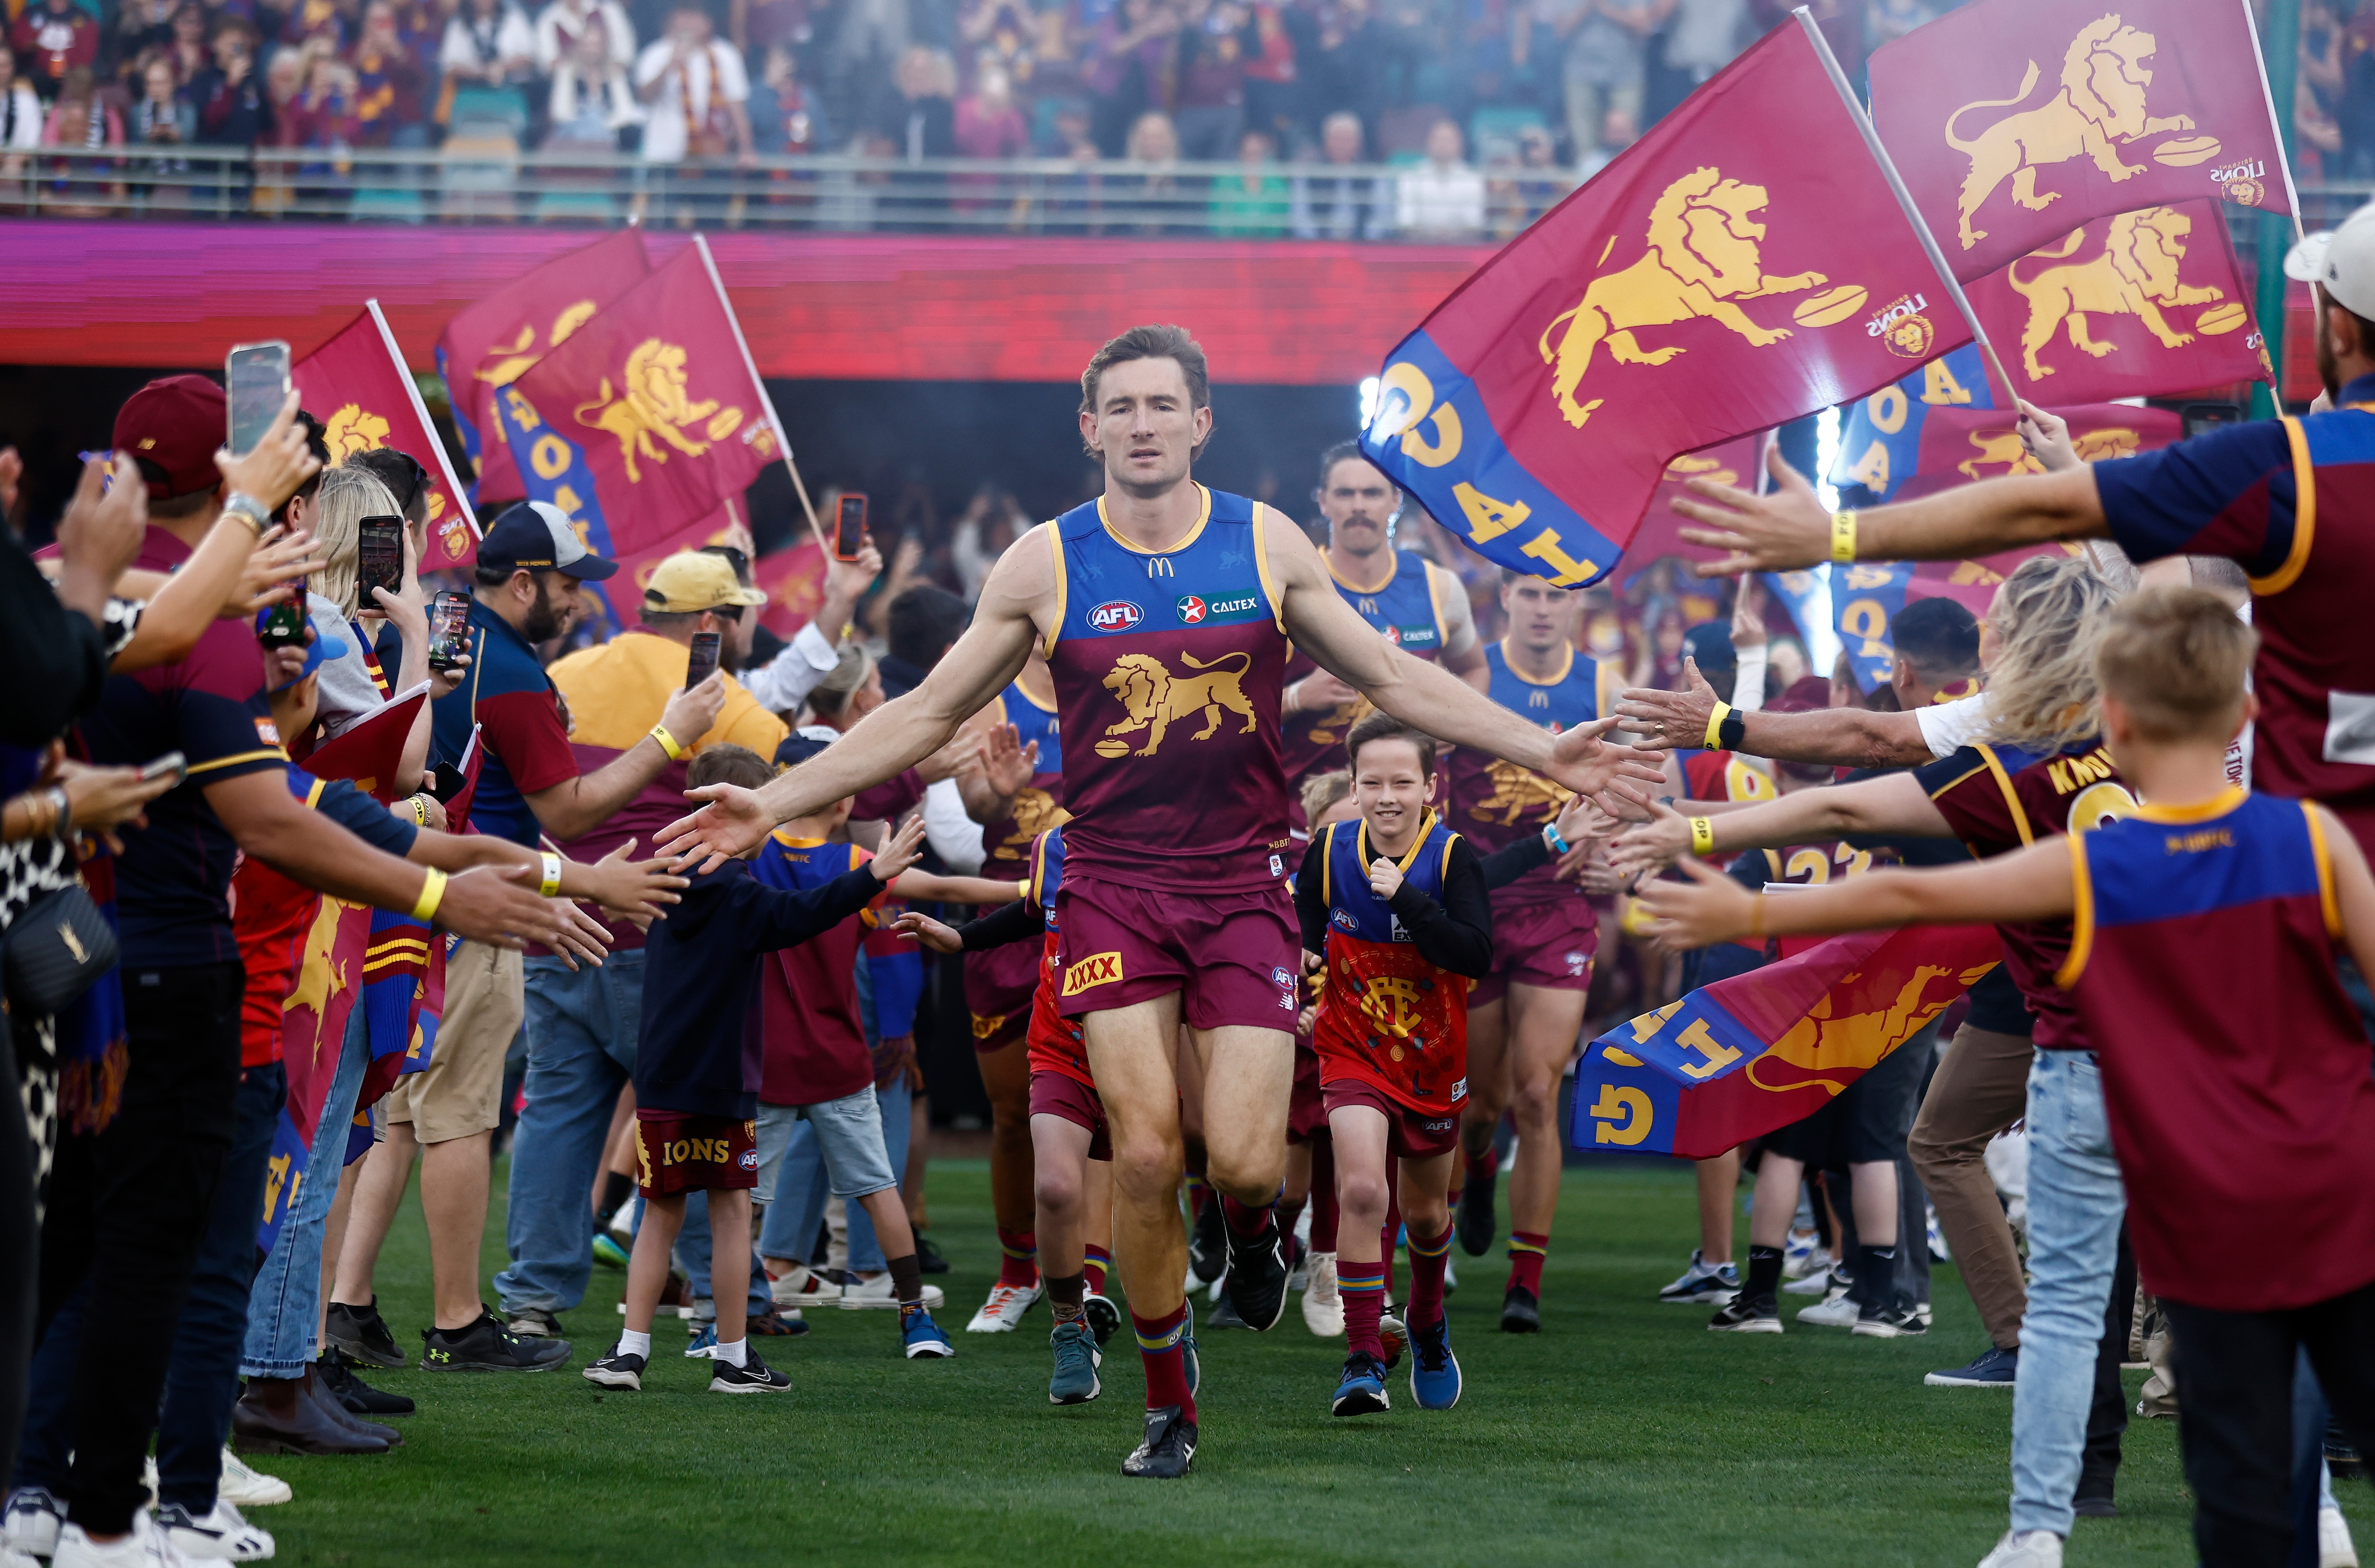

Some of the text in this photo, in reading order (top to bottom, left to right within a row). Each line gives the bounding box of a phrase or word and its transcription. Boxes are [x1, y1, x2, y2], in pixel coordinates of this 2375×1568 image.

[1211, 597, 1257, 614] CALTEX
[1092, 607, 1139, 626] AFL
[1403, 629, 1434, 642] CALTEX
[408, 798, 423, 818] FOP
[1046, 909, 1056, 922] AF
[1335, 911, 1356, 929] AFL
[1394, 932, 1411, 941] EX
[1067, 956, 1118, 992] XXXX
[1275, 971, 1293, 986] AFL
[1425, 1121, 1451, 1131] AFL
[663, 1138, 730, 1166] IONS
